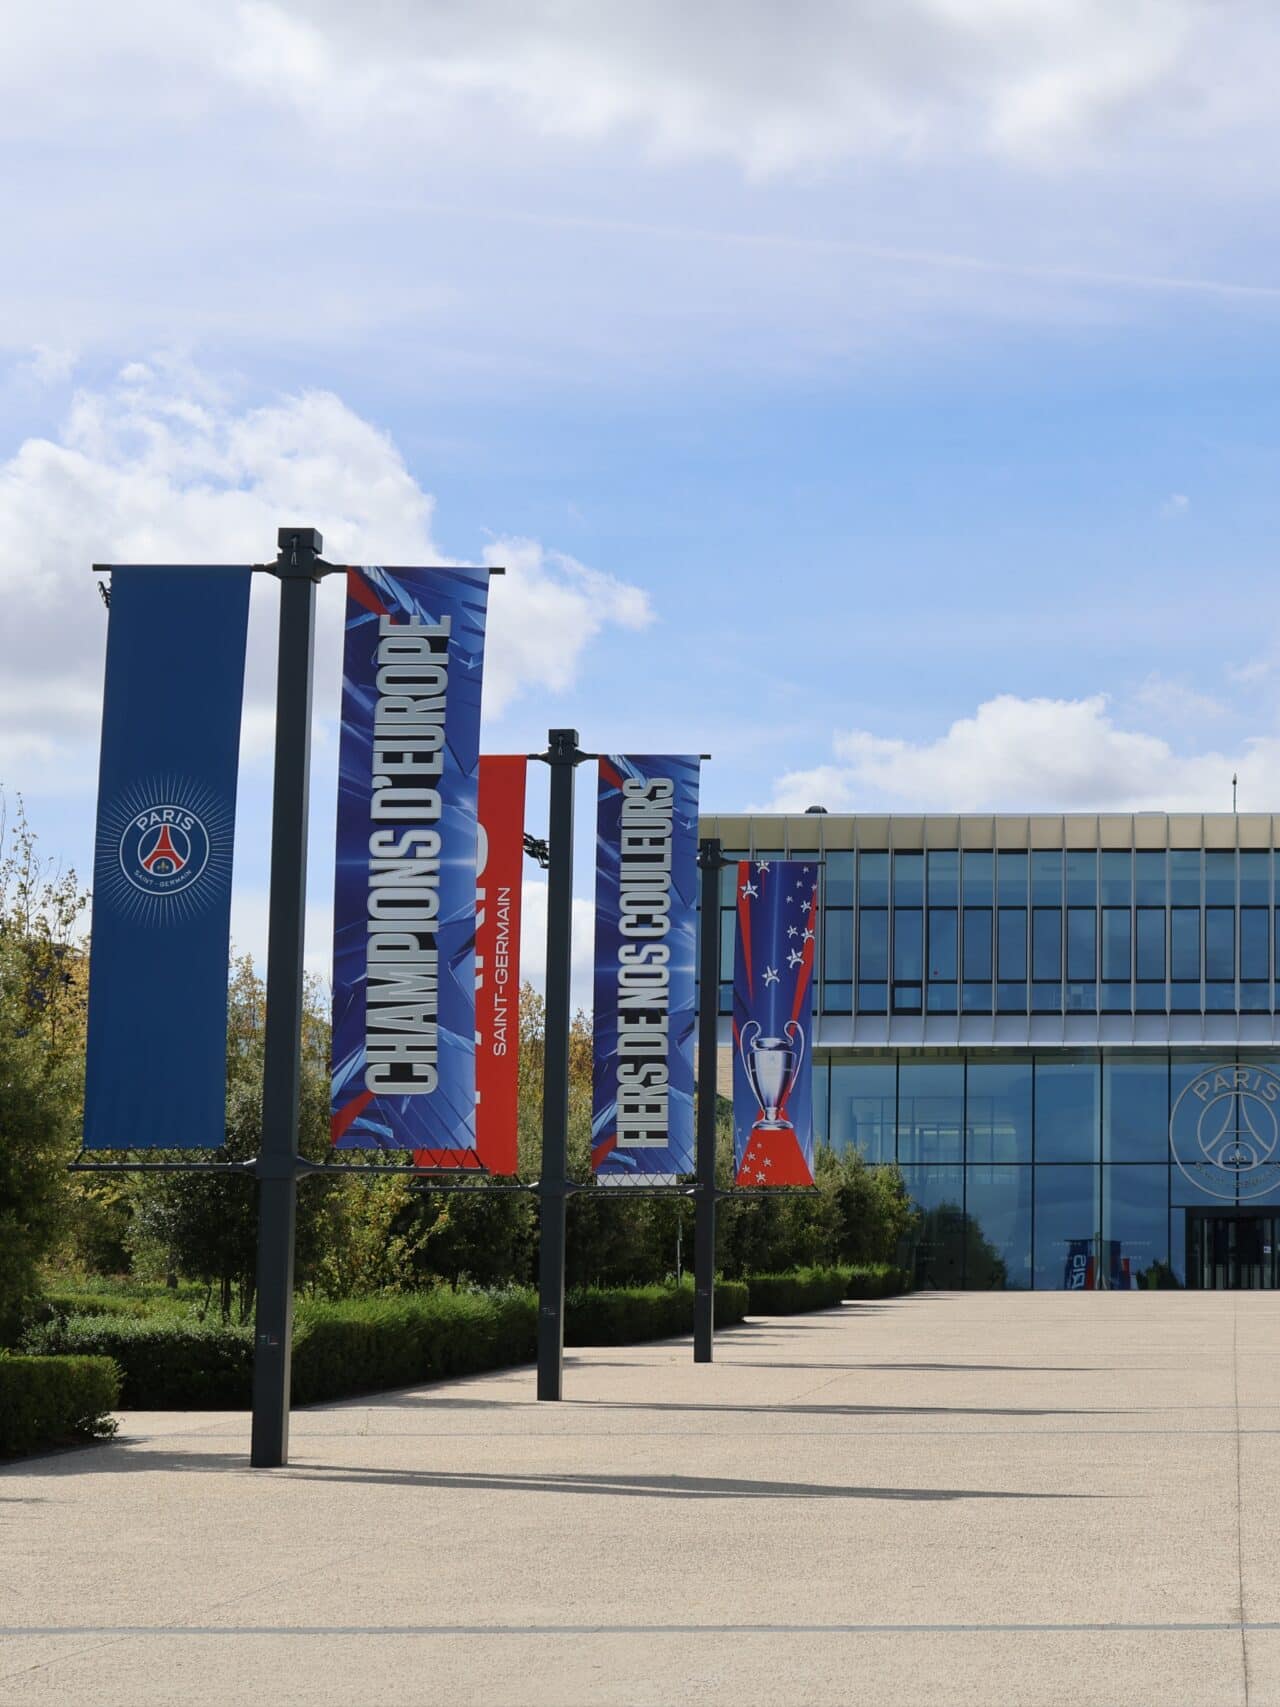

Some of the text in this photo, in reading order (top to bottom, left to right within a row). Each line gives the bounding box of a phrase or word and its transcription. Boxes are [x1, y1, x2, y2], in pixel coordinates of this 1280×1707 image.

[136, 809, 195, 831] PARIS
[364, 614, 452, 1095] CHAMPIONS D'EUROPE
[493, 887, 511, 1056] SAINT-GERMAIN
[616, 777, 674, 1148] FIERS DE NOS COULEURS
[1192, 1071, 1280, 1101] PARIS
